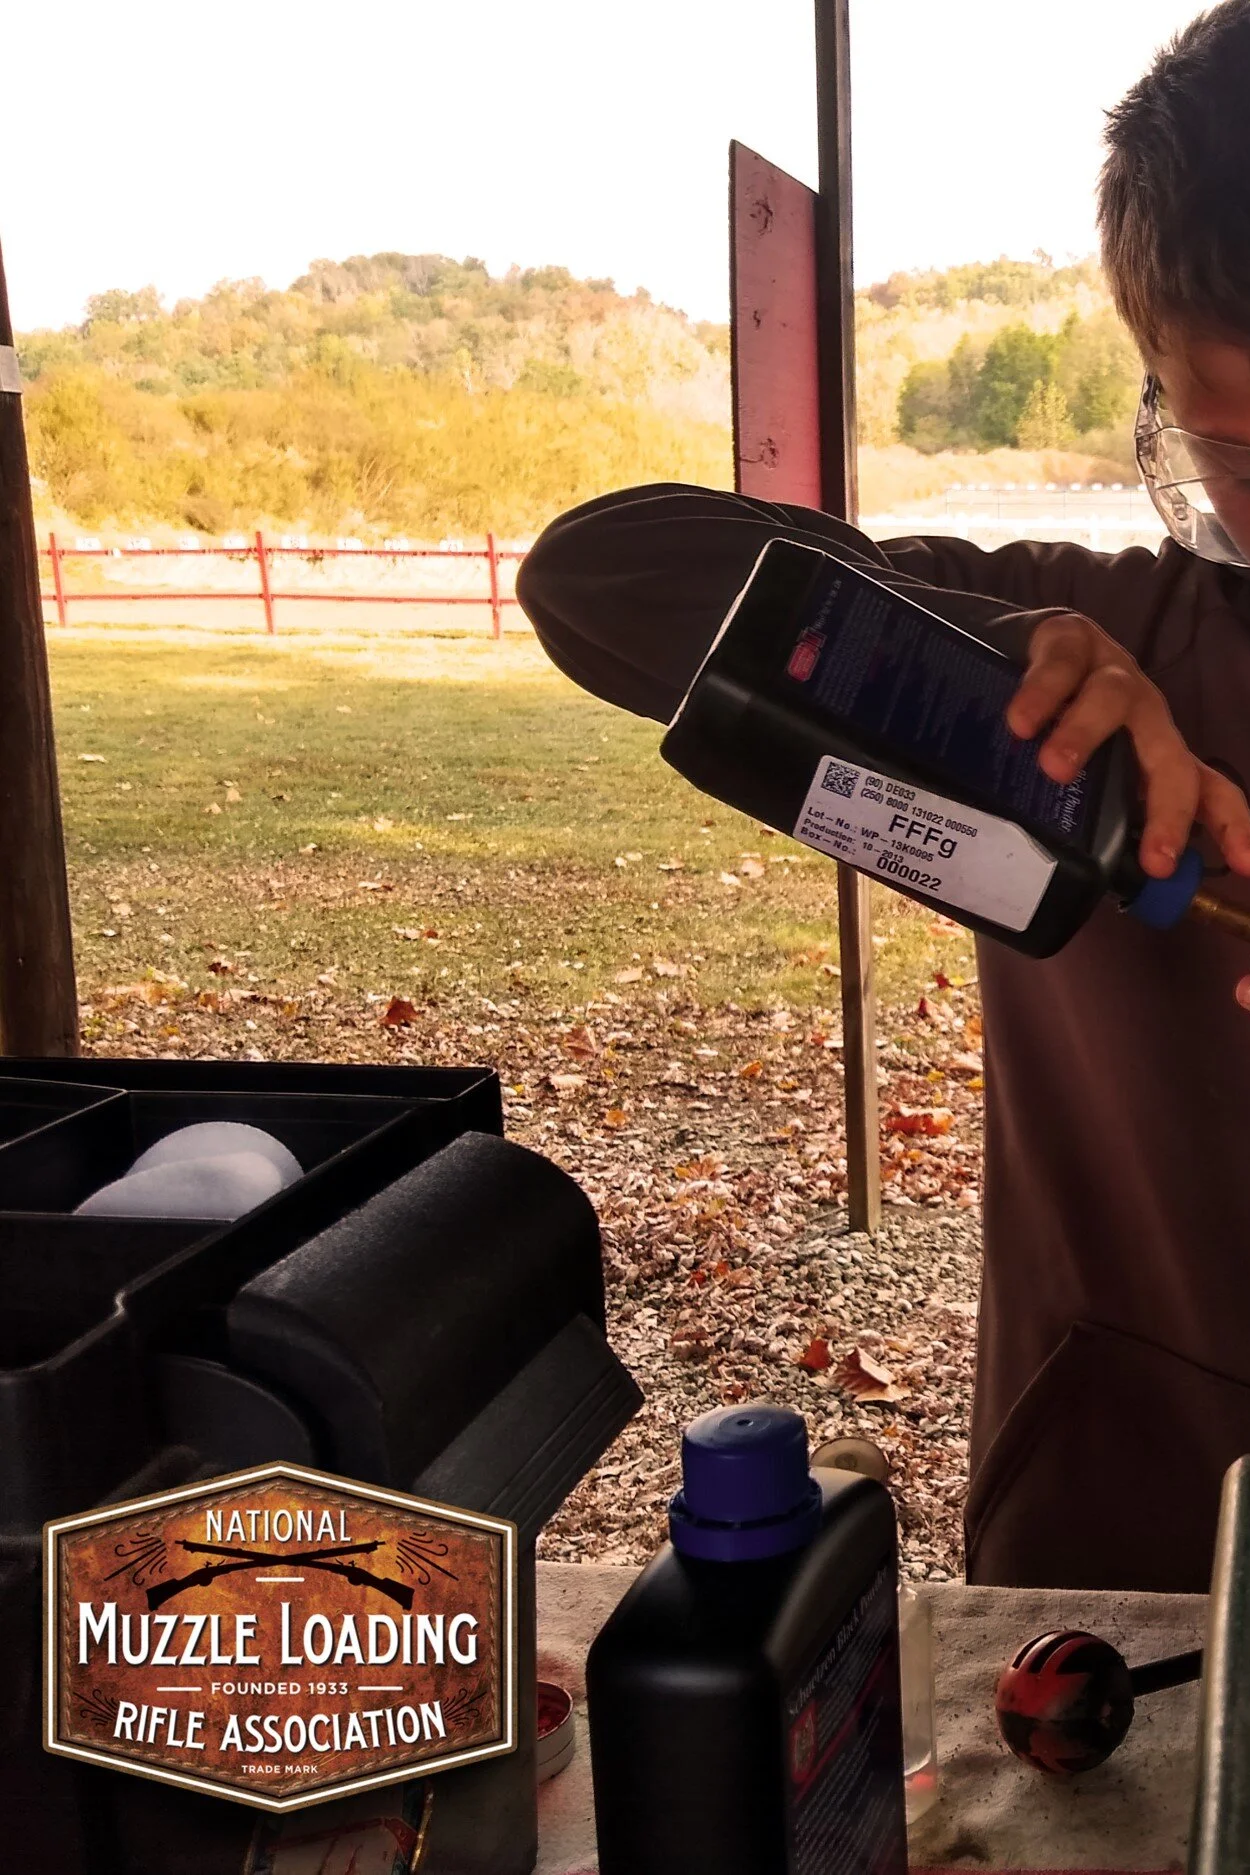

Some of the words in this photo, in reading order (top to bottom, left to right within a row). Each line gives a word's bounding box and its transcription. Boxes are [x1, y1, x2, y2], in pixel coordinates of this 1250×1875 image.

[865, 776, 884, 790] (90)
[885, 783, 916, 801] DE033
[860, 789, 884, 804] (250)
[886, 797, 909, 812] 8000
[912, 806, 944, 825] 131022
[944, 819, 978, 838] 000550
[804, 819, 857, 845] Production:
[888, 814, 958, 859] FFFg
[876, 857, 942, 891] 000022
